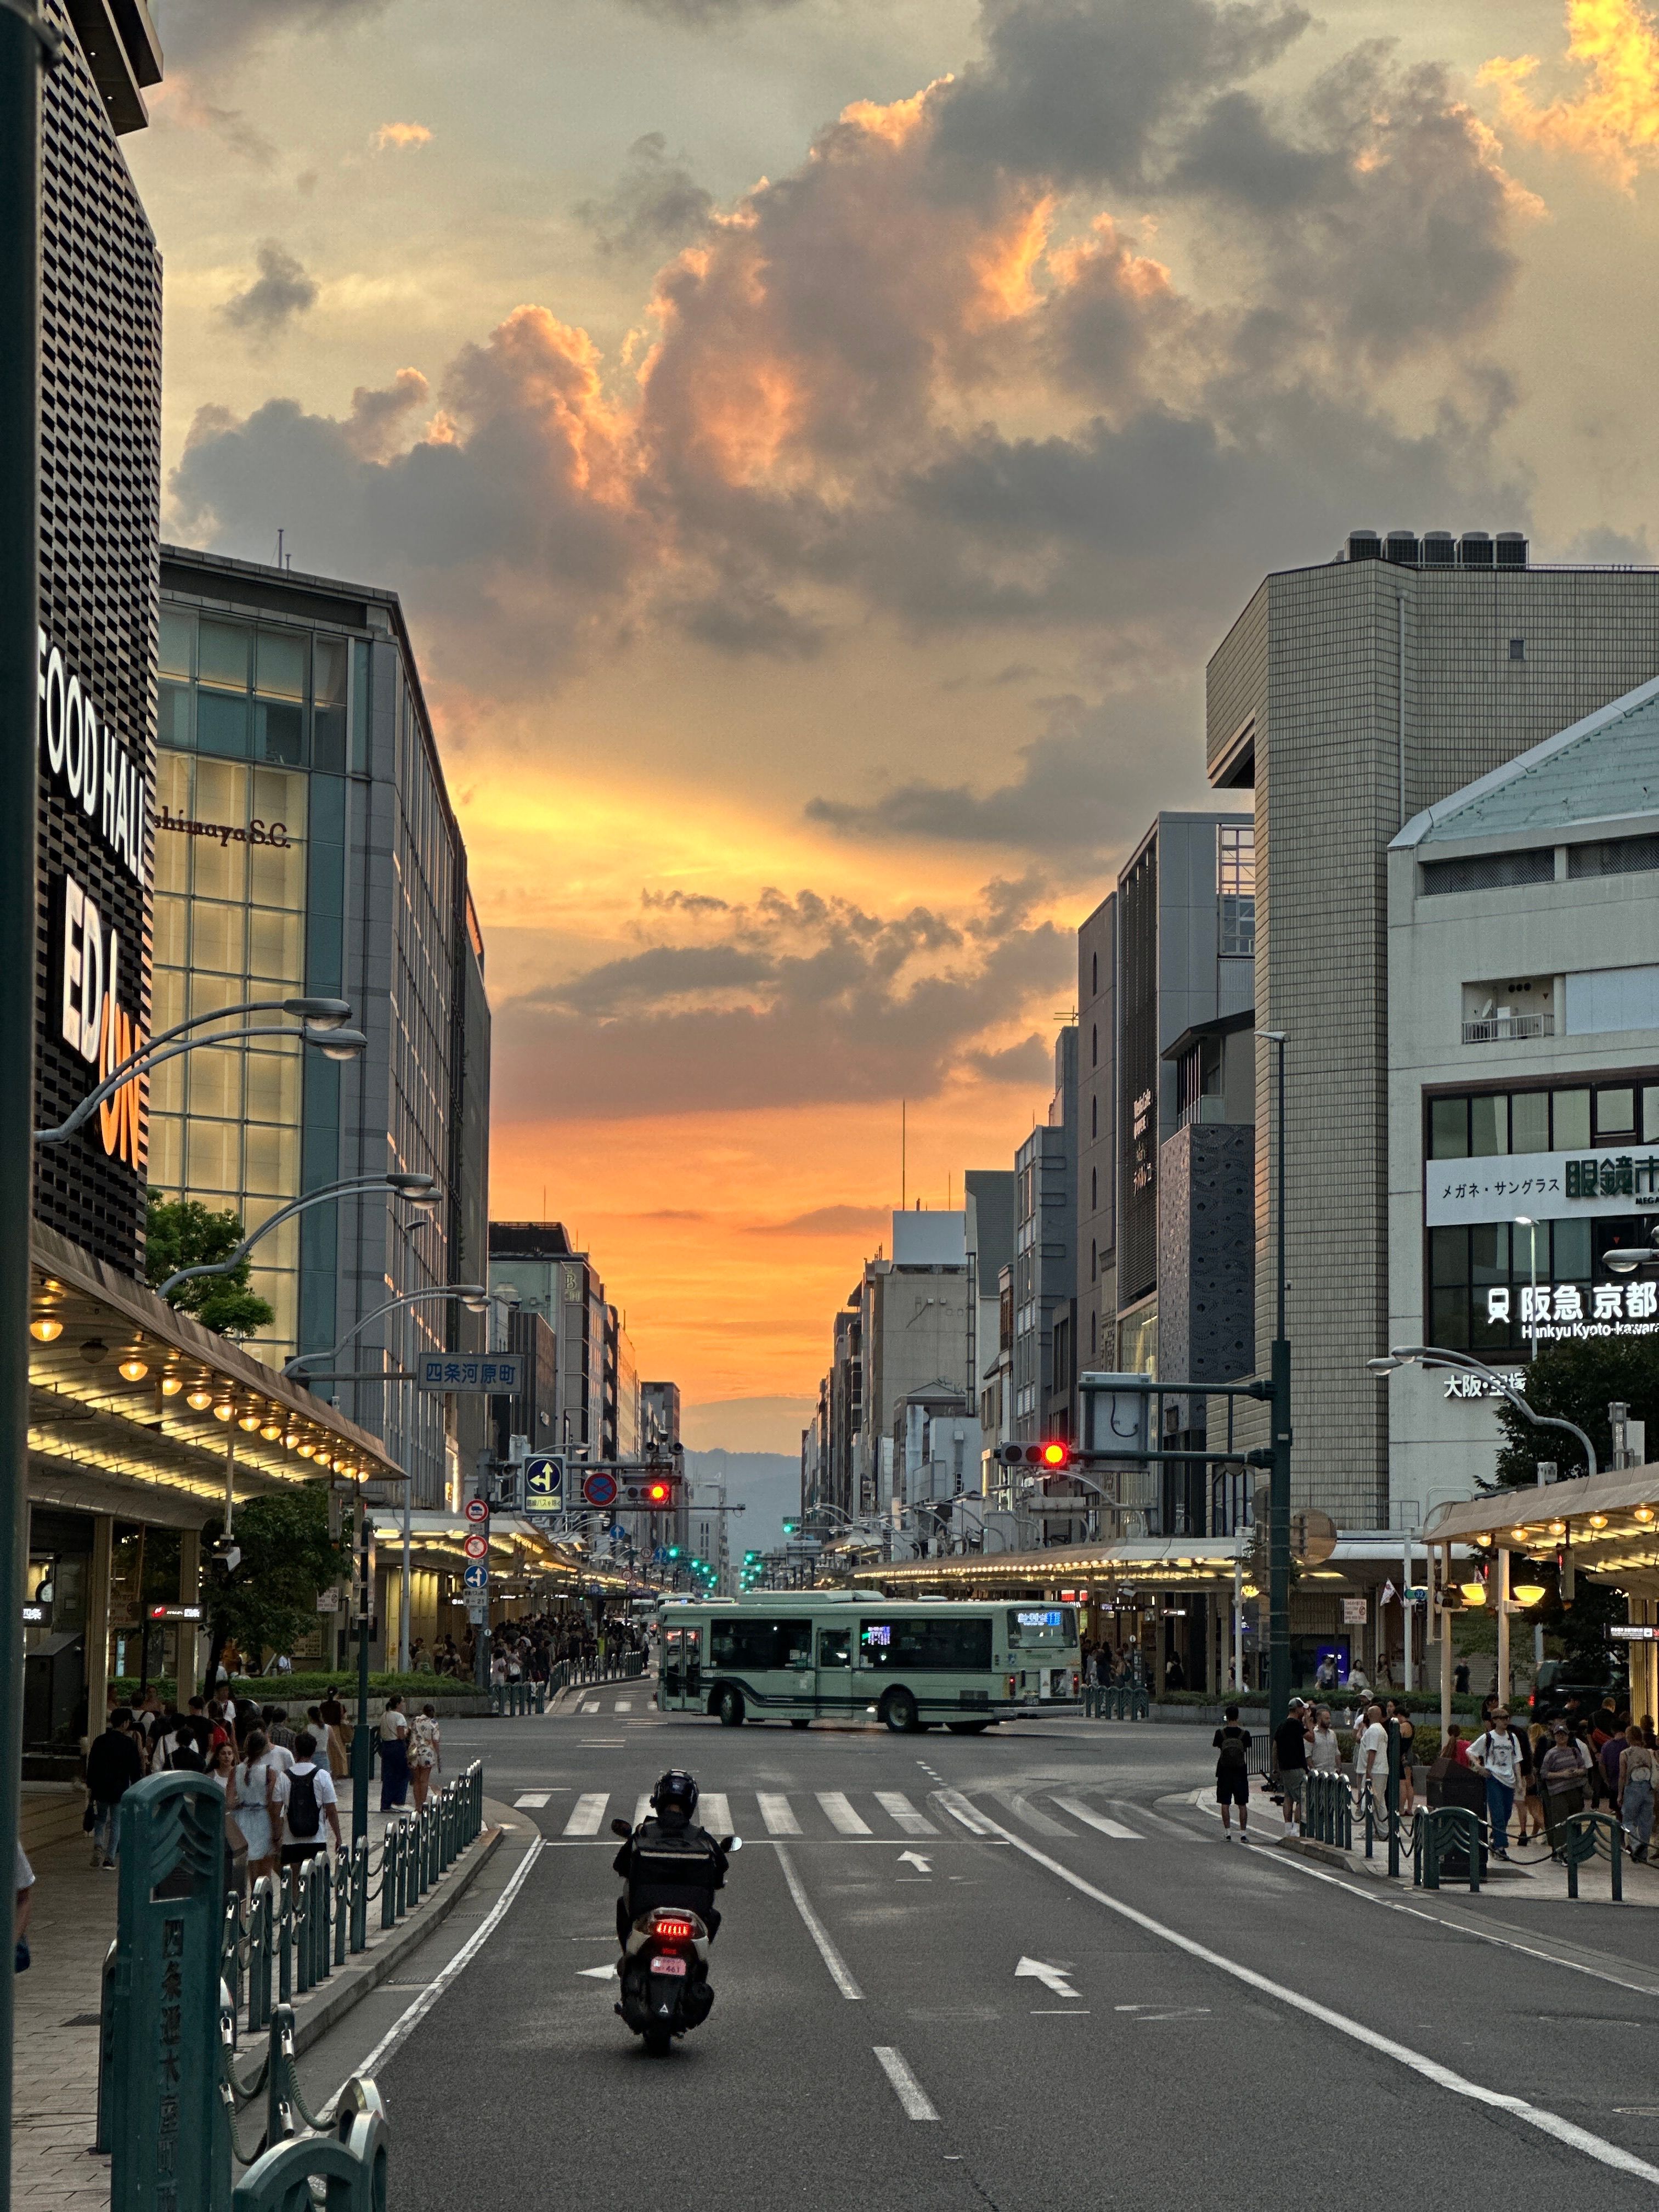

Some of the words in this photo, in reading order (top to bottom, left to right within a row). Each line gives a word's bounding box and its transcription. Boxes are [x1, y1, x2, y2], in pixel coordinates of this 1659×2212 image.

[103, 725, 144, 885] HALL
[62, 873, 142, 1171] EDION
[1443, 1178, 1560, 1198] メガネ・サングラス
[1521, 1284, 1583, 1322] 阪急
[1593, 1281, 1657, 1319] 京都
[1522, 1324, 1571, 1341] Hankyu
[426, 1363, 516, 1385] 四条河原町
